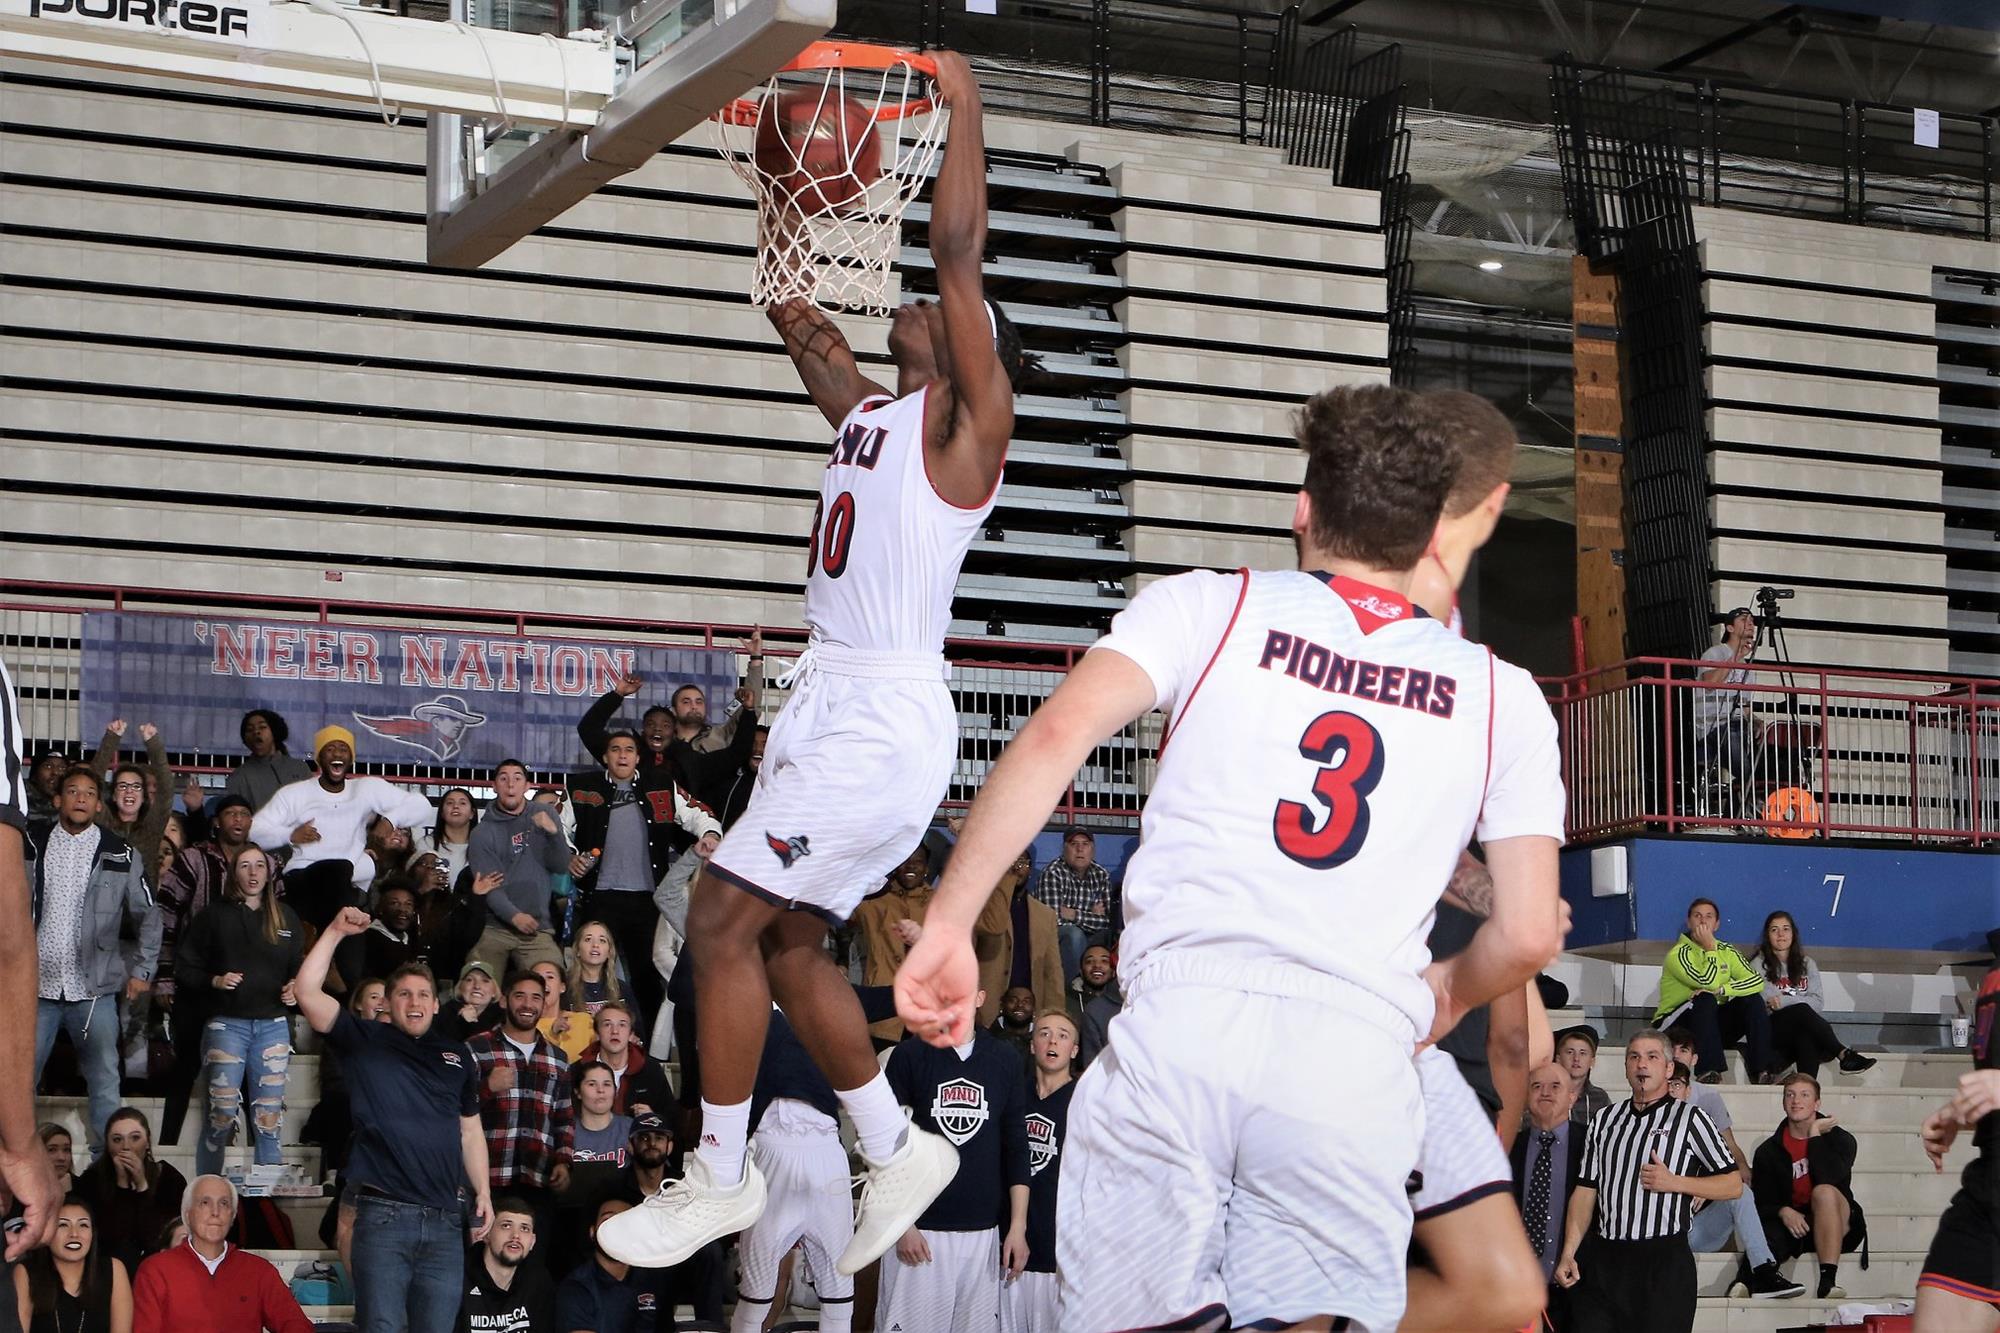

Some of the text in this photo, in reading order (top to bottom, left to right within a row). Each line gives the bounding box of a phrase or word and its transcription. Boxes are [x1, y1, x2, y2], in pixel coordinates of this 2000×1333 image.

[400, 635, 635, 698] NATION
[1257, 629, 1457, 720] PIONEERS
[1273, 710, 1385, 870] 3
[1823, 874, 1846, 917] 7
[943, 1086, 979, 1106] MNU
[1025, 1120, 1049, 1140] NU
